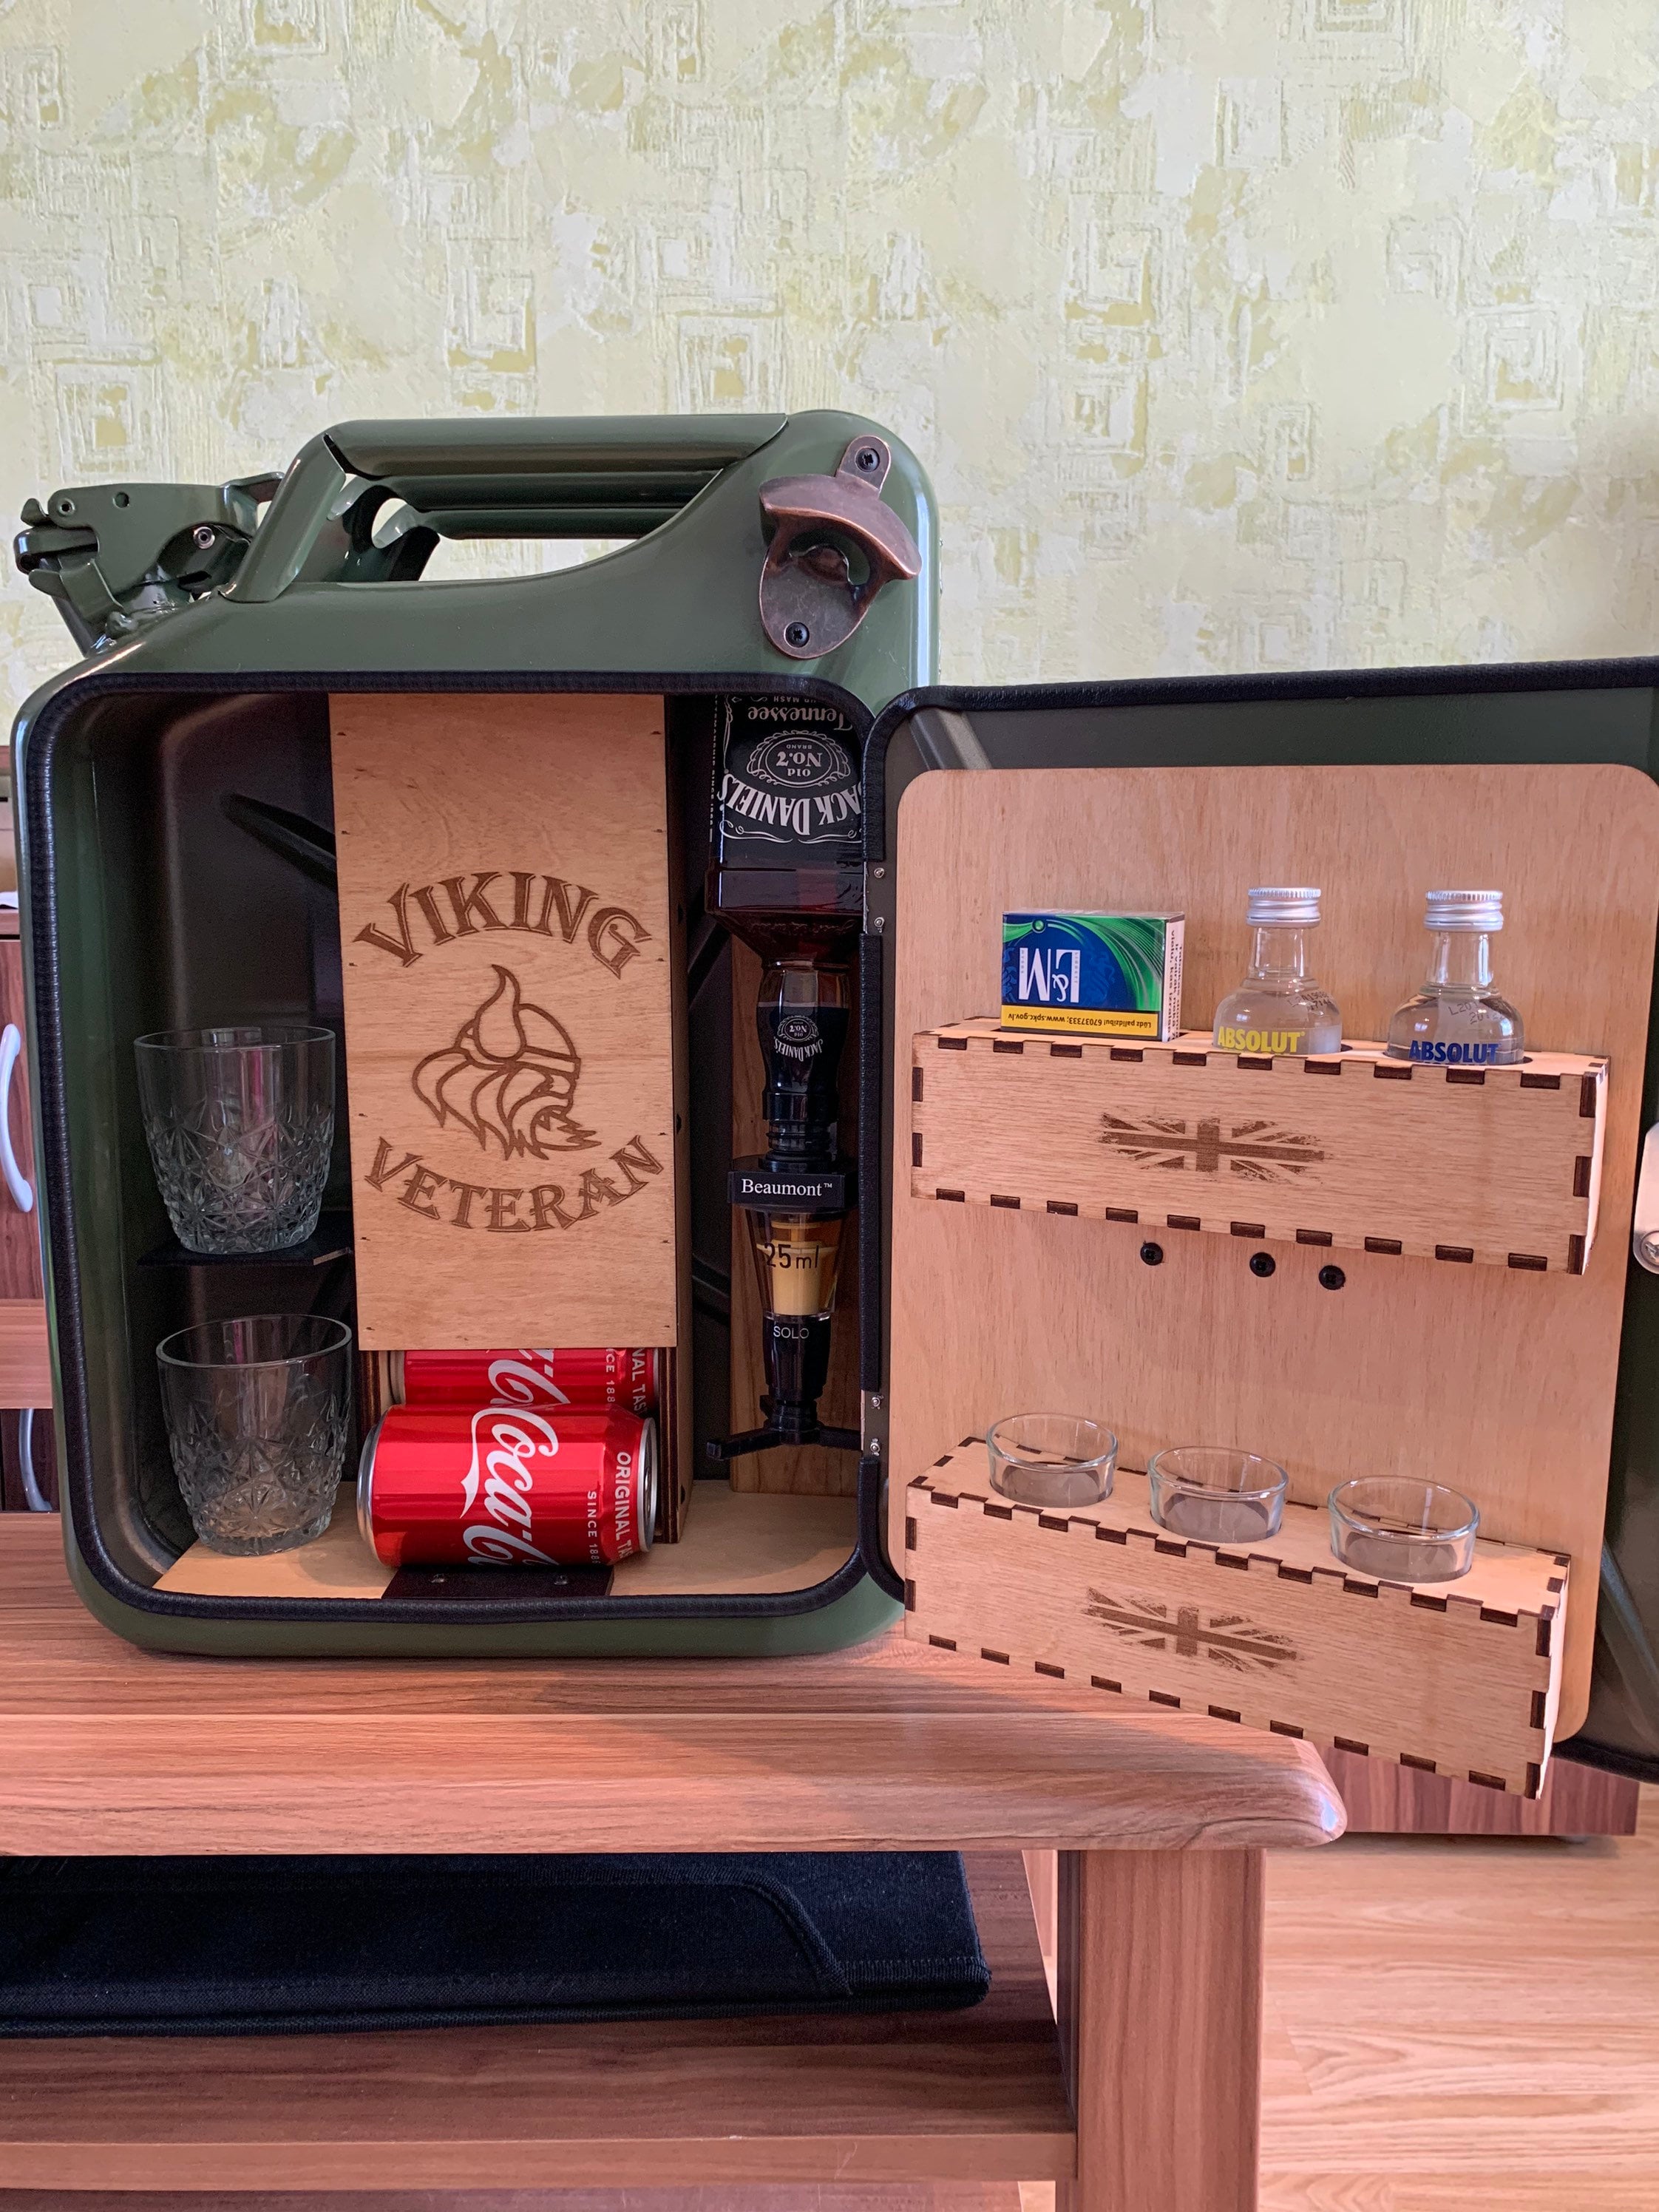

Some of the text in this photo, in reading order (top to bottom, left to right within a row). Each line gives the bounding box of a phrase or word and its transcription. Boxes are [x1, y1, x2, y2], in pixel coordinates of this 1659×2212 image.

[747, 706, 853, 730] Tennessee
[787, 768, 811, 777] Old
[716, 773, 811, 836] DANIEL'S
[353, 871, 652, 980] VIKING
[1018, 947, 1081, 1003] L&M
[1008, 1012, 1065, 1022] www.spkc.gov.lv
[1067, 1017, 1102, 1026] 67037333;
[804, 1039, 823, 1058] JACK
[1218, 1026, 1301, 1053] ABSOLUT
[1409, 1039, 1499, 1065] ABSOLUT
[364, 1135, 664, 1232] VETERAN
[773, 1326, 810, 1339] SOLO
[631, 1348, 645, 1382] NAL
[606, 1380, 616, 1402] 188
[615, 1451, 632, 1541] ORIGINAL
[587, 1490, 597, 1538] SINCE
